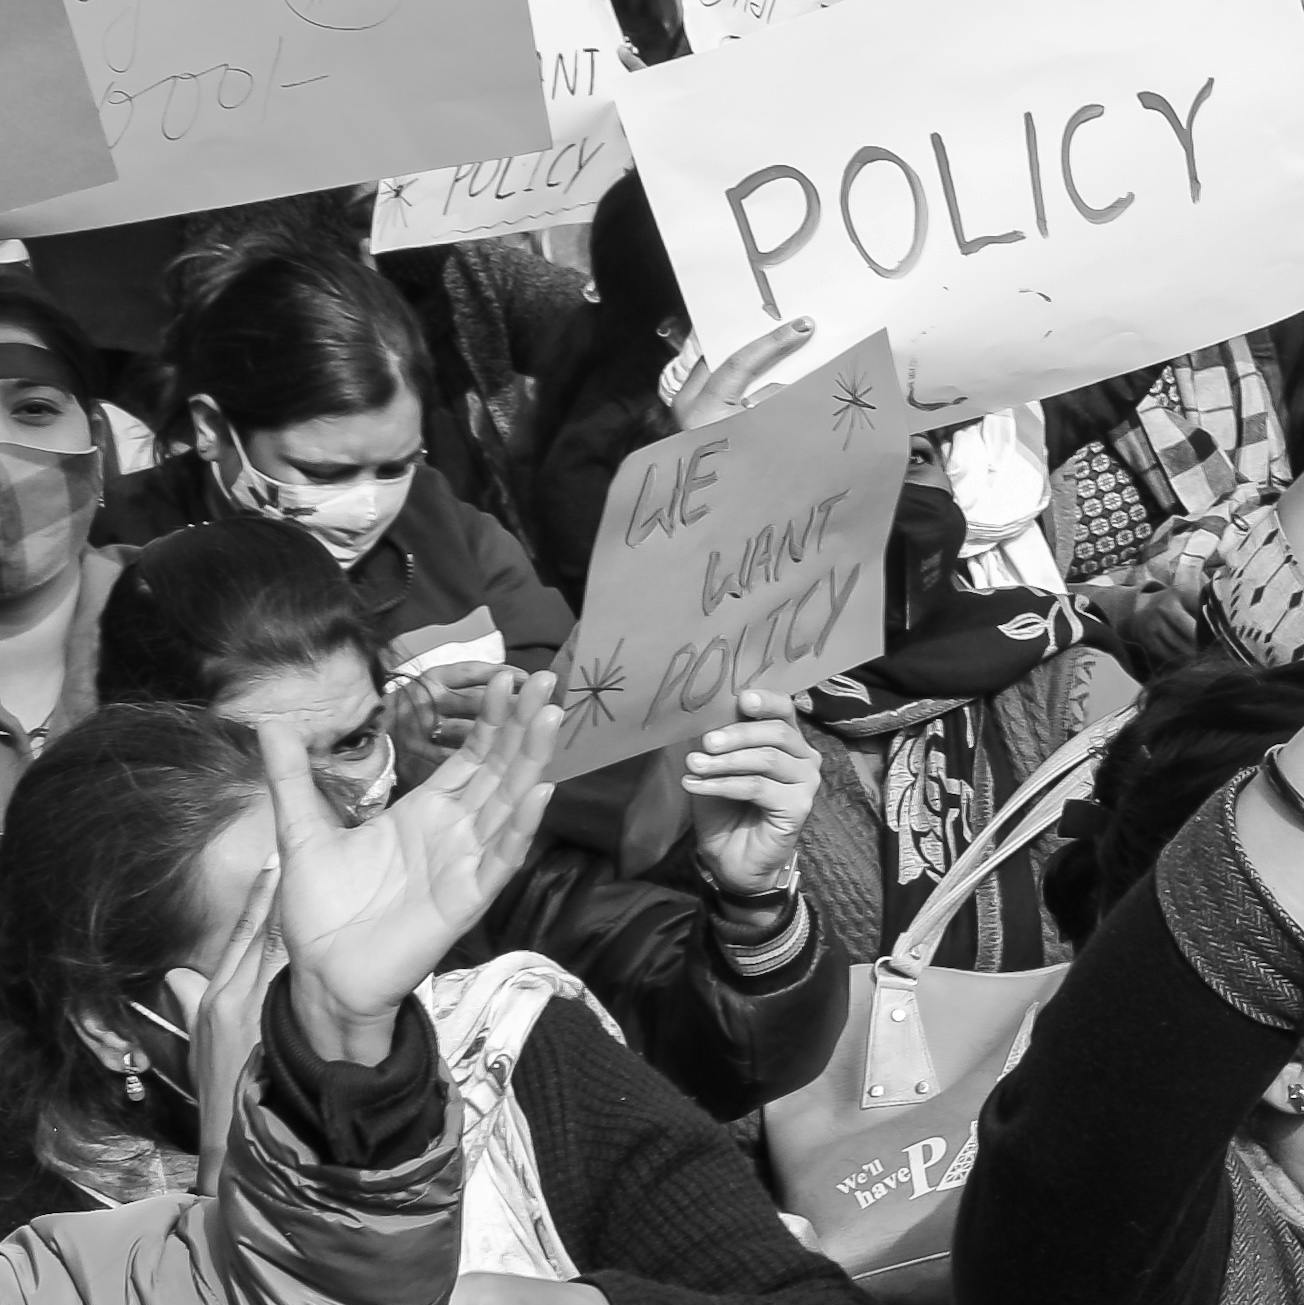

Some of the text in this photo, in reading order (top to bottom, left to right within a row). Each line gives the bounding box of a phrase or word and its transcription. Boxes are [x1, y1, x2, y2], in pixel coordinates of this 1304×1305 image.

[725, 76, 1216, 322] POLICY
[626, 438, 729, 548] WE
[702, 487, 852, 616] WANT
[641, 562, 862, 730] POLICY
[835, 1158, 885, 1194] we'll
[854, 1167, 911, 1209] have
